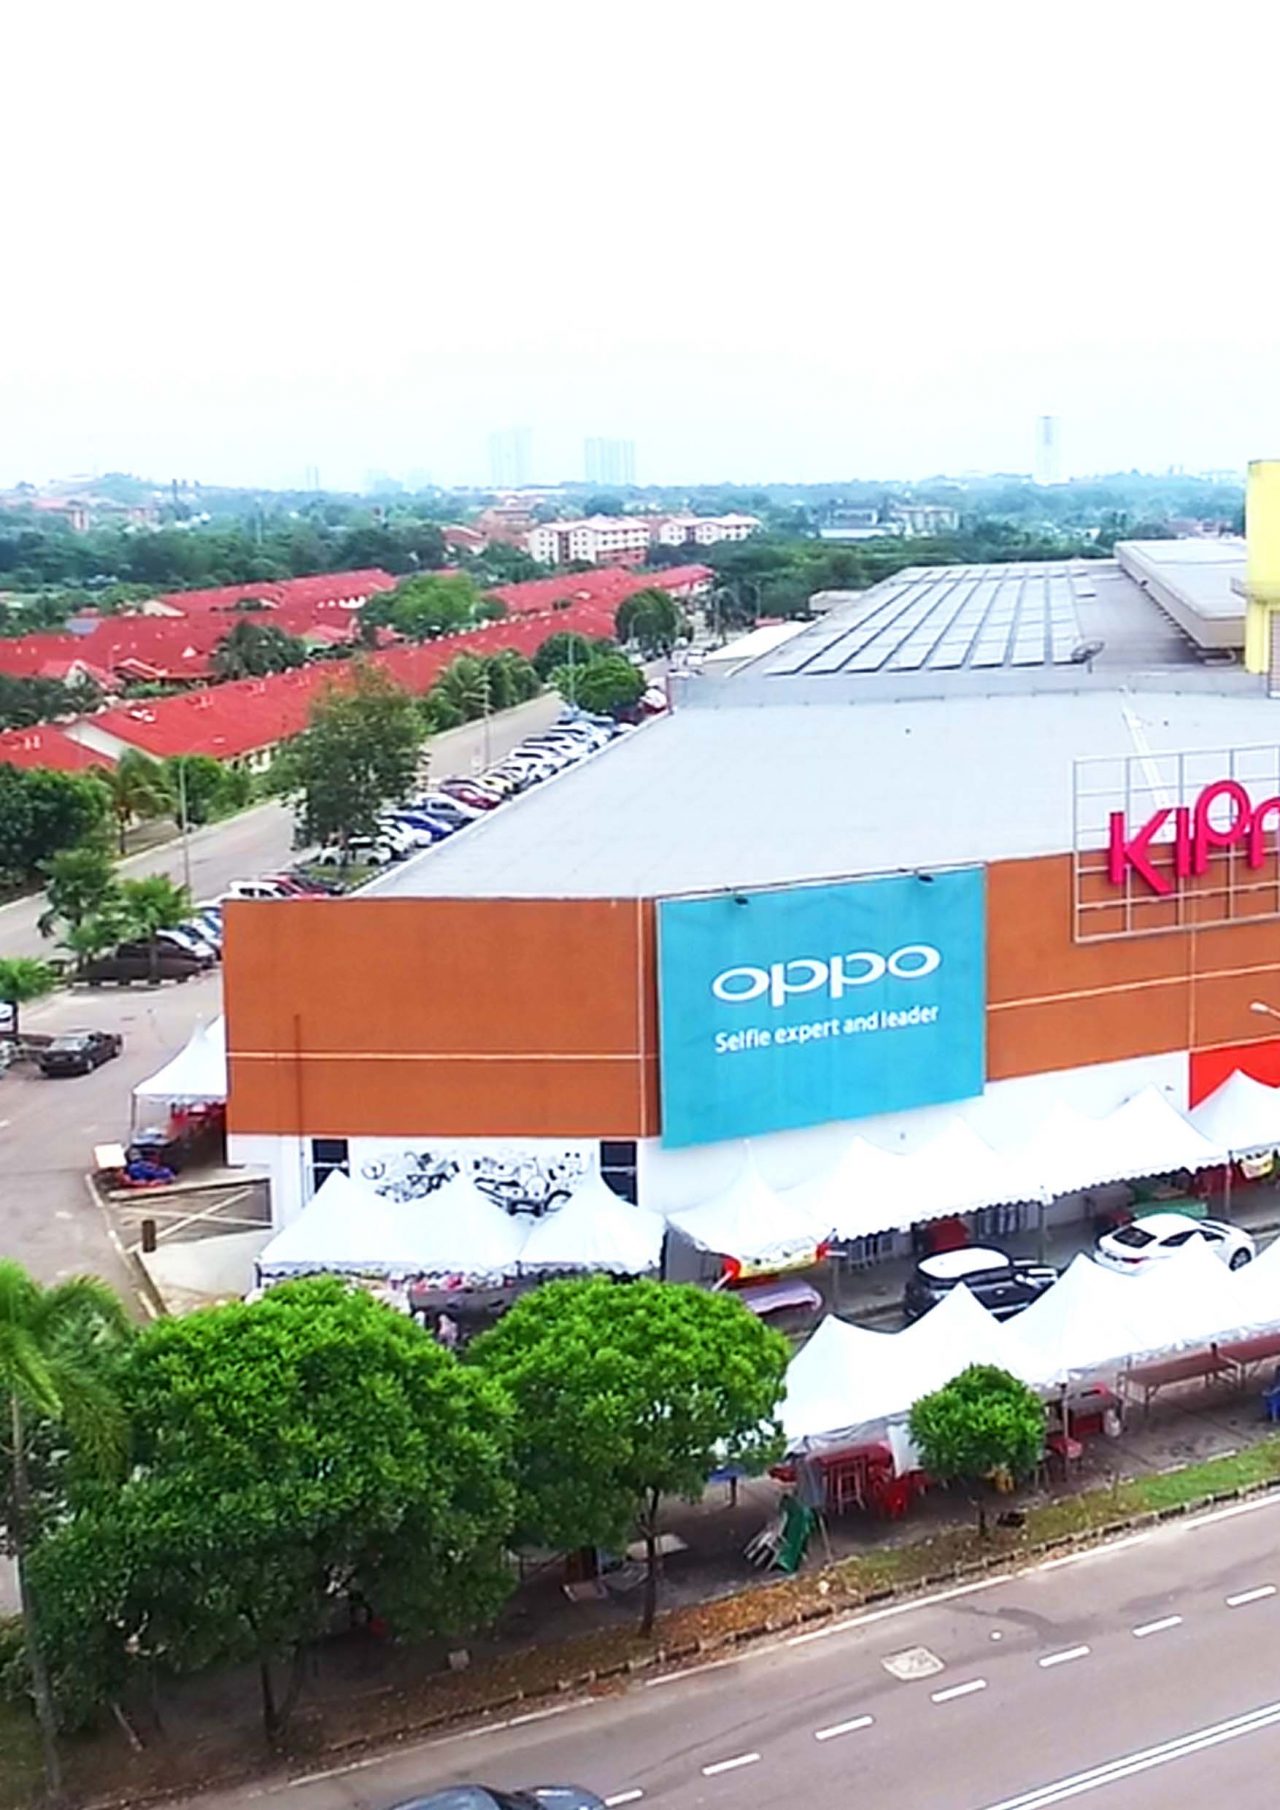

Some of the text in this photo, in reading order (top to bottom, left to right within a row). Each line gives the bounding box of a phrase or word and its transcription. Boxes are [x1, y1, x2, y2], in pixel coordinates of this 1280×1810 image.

[715, 1005, 938, 1053] Selfie expert and leader
